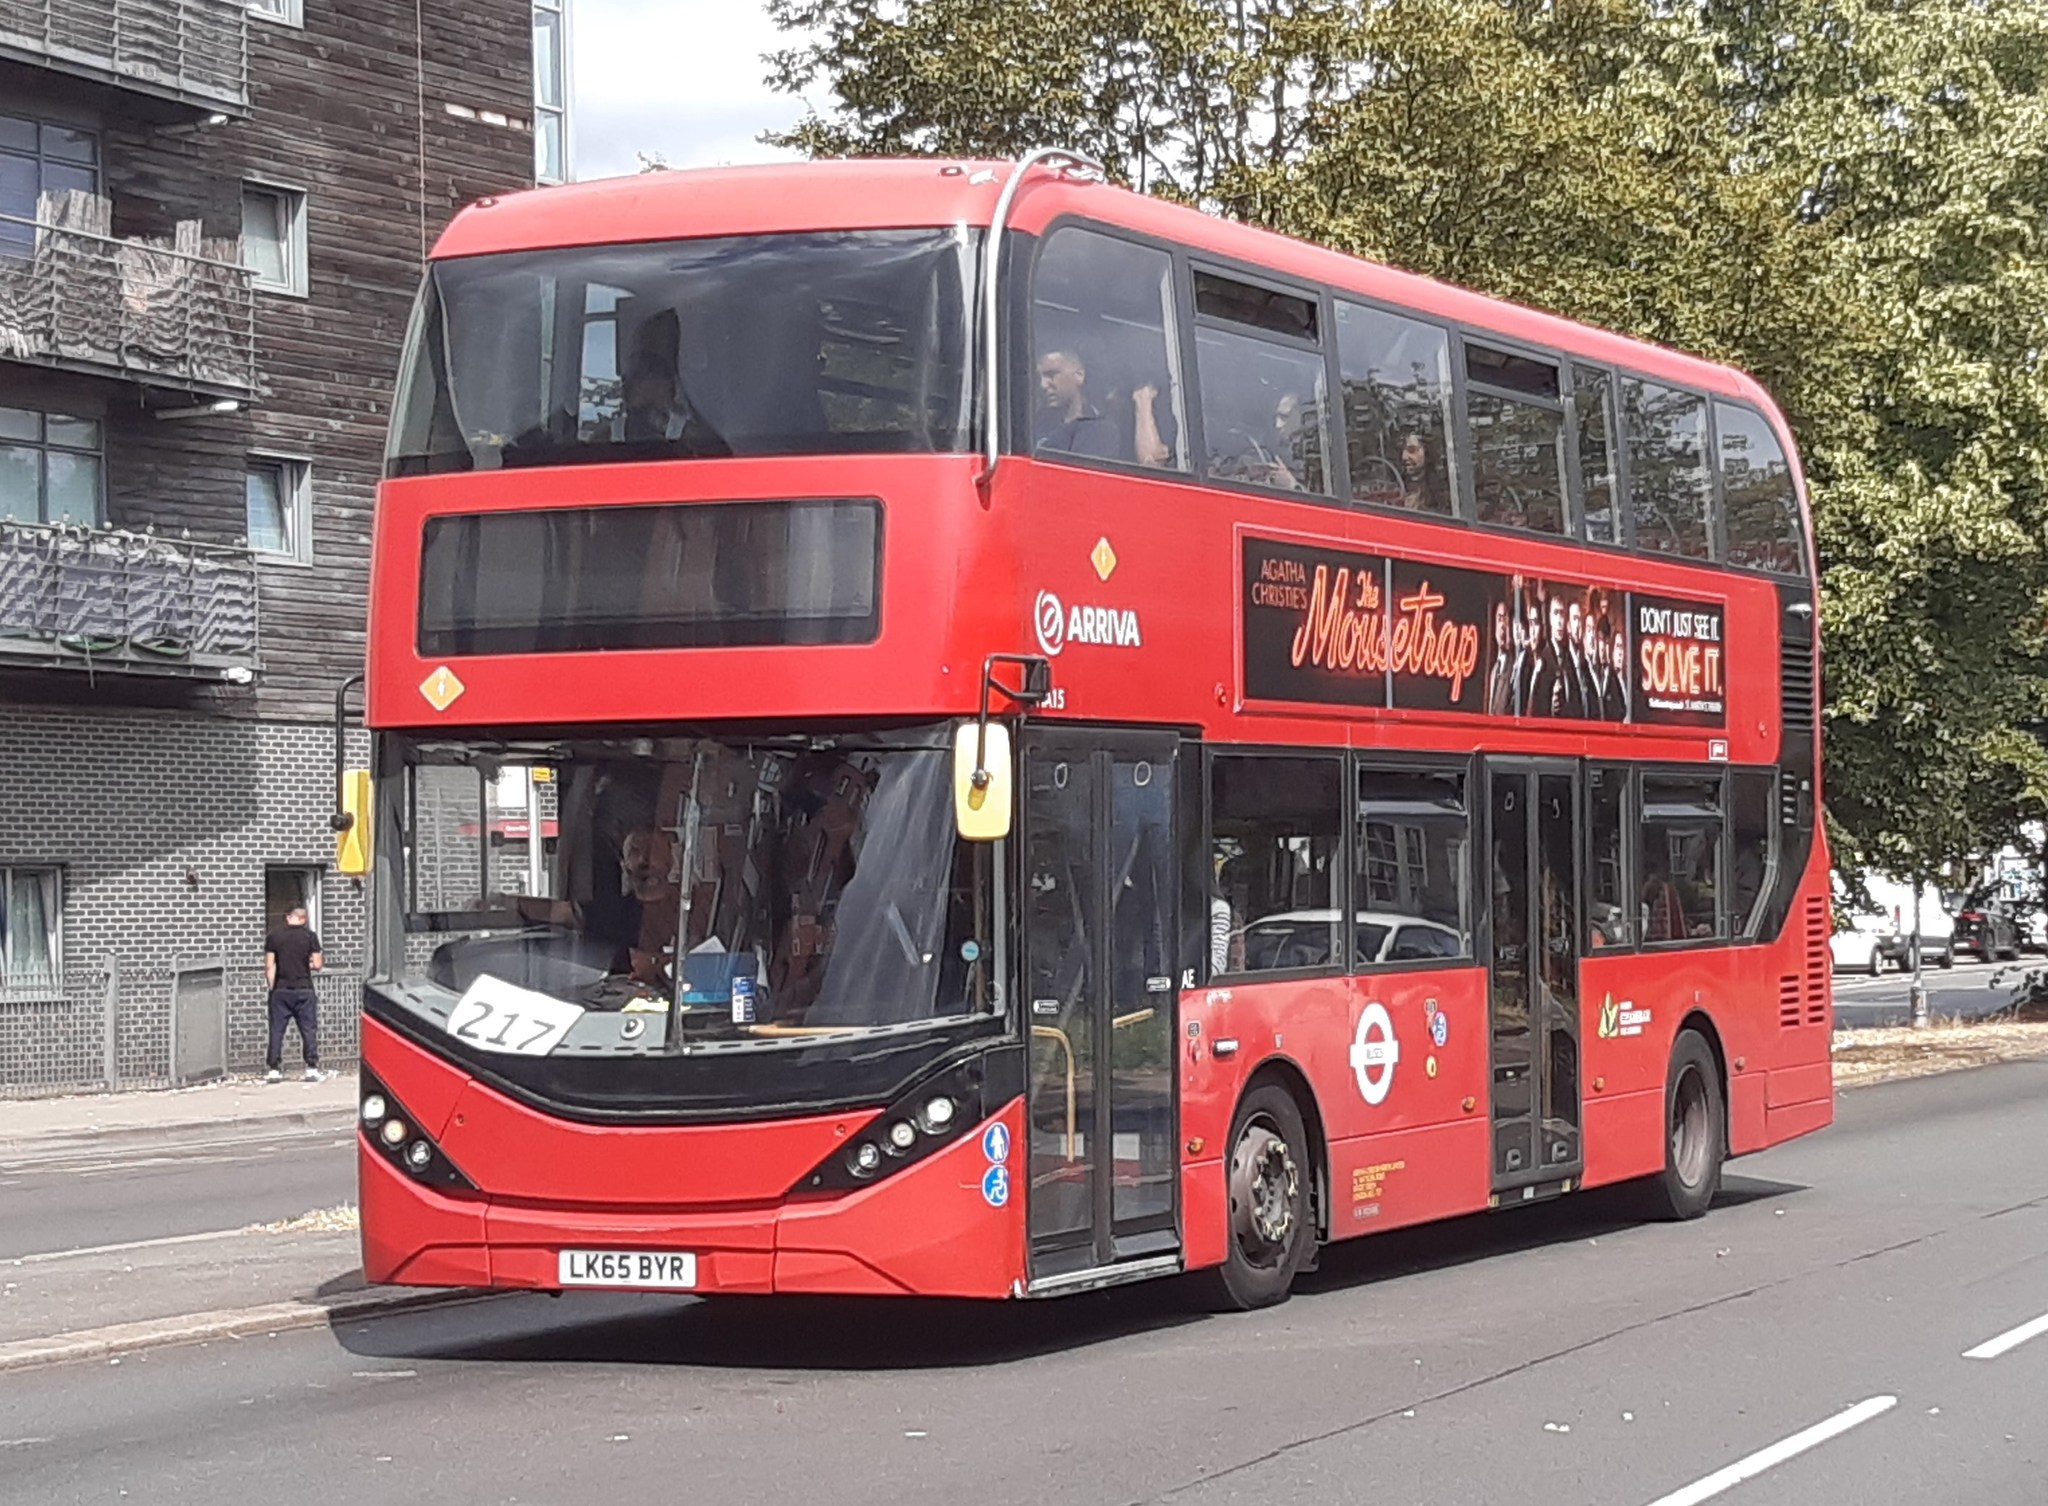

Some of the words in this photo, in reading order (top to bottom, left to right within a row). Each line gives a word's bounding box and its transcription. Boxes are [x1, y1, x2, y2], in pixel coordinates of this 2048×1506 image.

[1261, 559, 1306, 584] AGATHA
[1356, 571, 1379, 609] The
[1067, 605, 1140, 646] ARRIVA
[1292, 565, 1478, 702] Mousetrap
[1672, 611, 1692, 637] JUST
[1694, 614, 1709, 640] SEE
[1641, 639, 1700, 694] SOLVE
[1704, 647, 1722, 696] IT.
[1181, 969, 1195, 989] AE
[457, 1001, 556, 1050] 217
[570, 1254, 631, 1279] LK65
[638, 1255, 684, 1280] BYR
